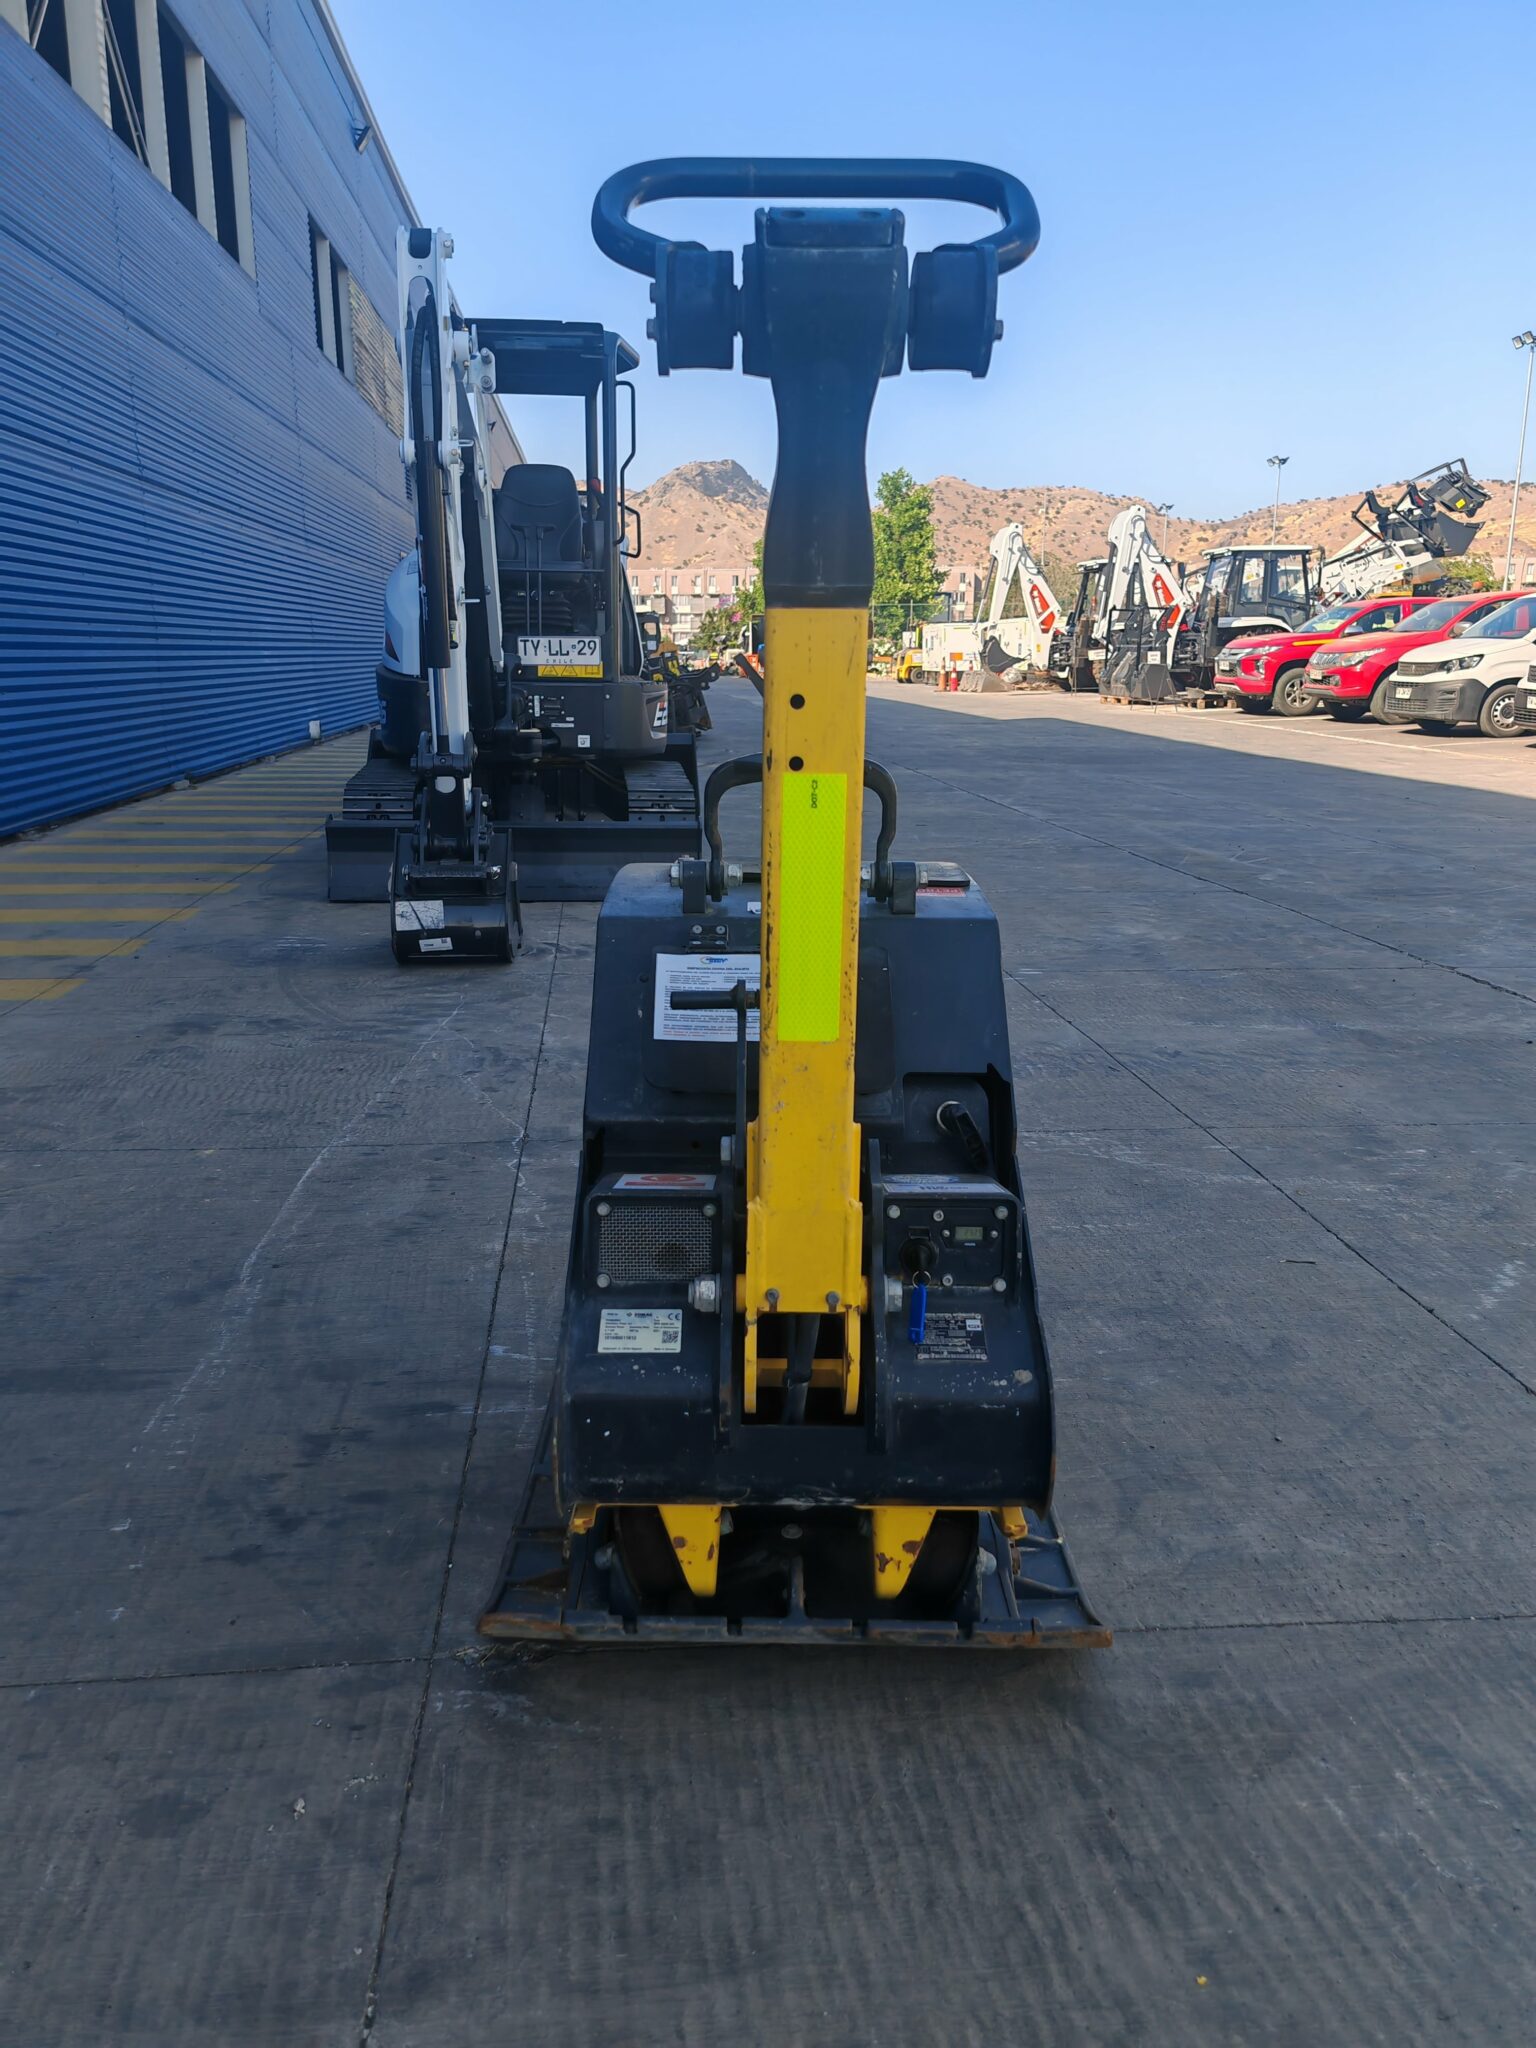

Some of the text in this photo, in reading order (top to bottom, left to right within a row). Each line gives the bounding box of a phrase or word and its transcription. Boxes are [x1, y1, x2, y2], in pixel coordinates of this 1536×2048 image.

[520, 639, 597, 656] TY LL 29
